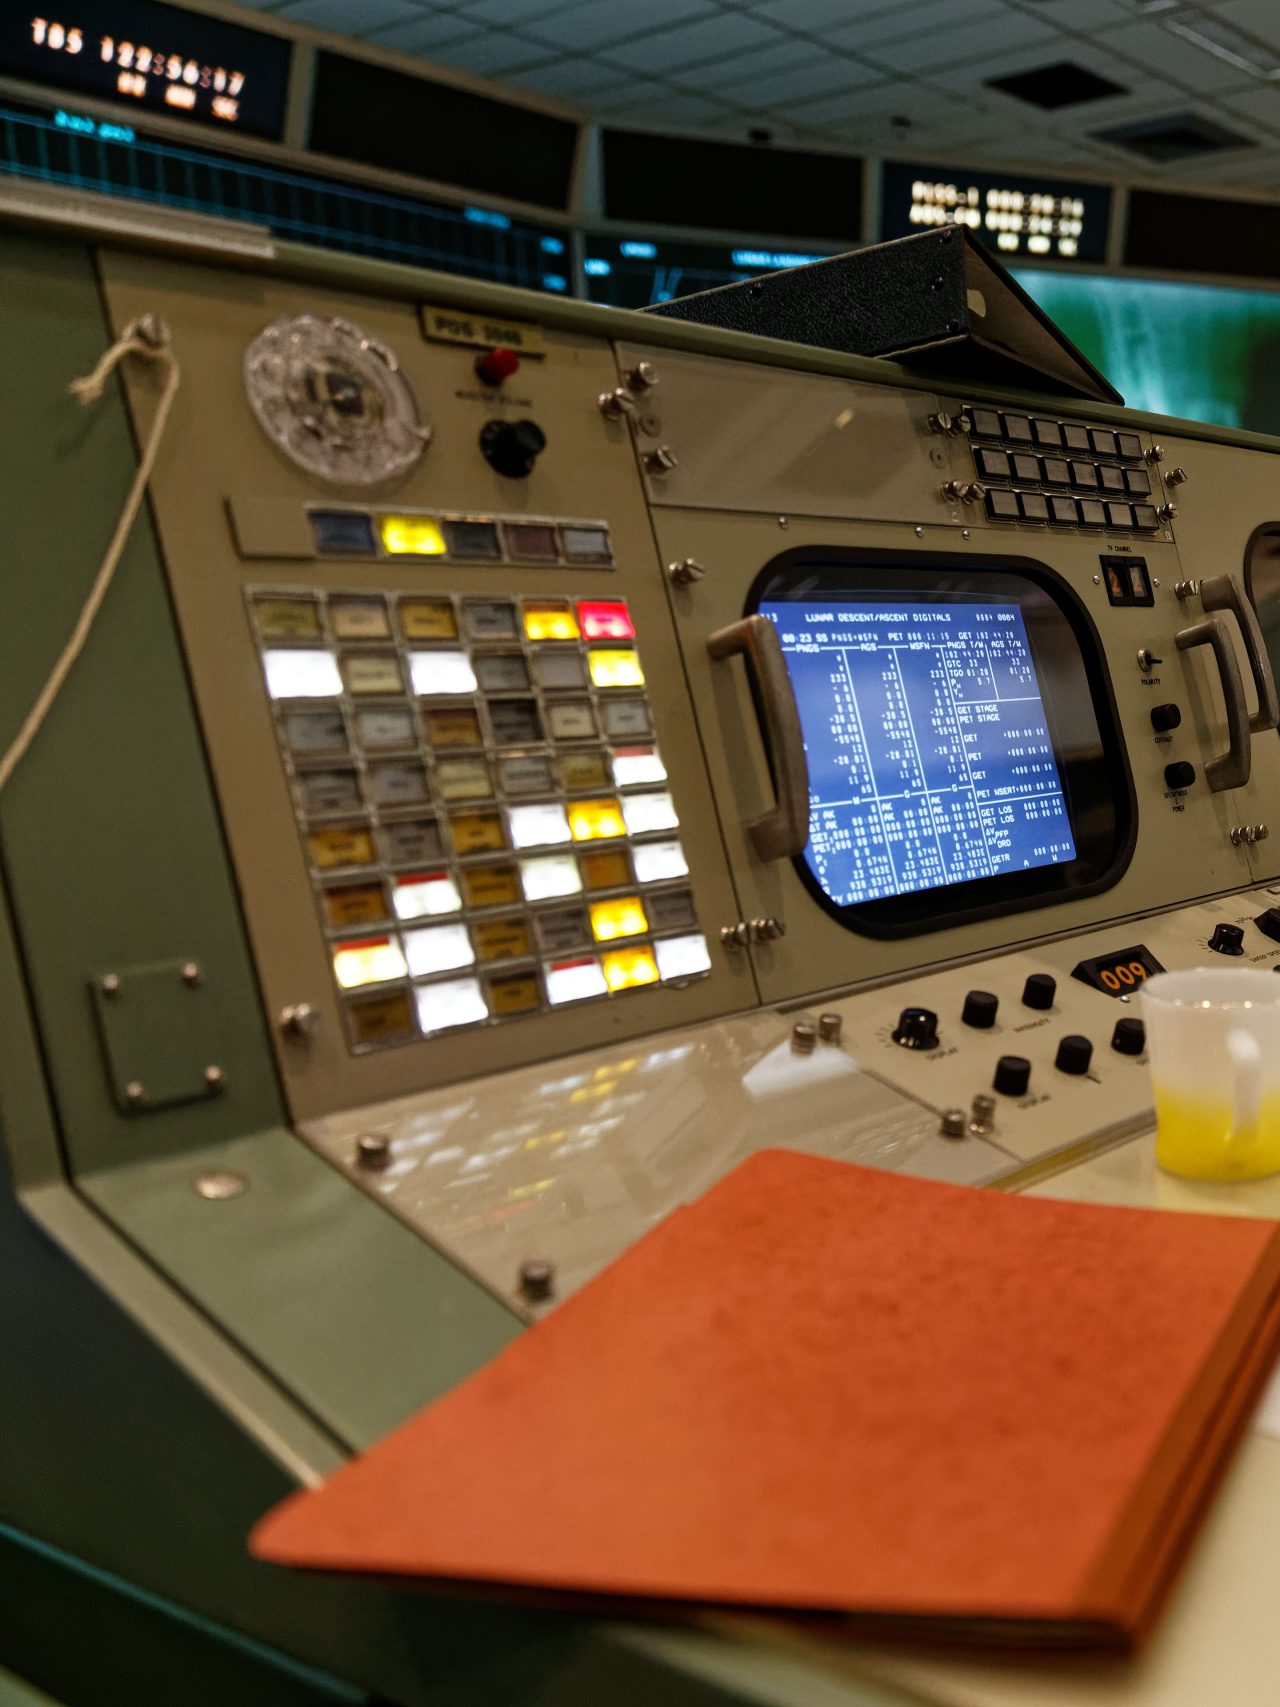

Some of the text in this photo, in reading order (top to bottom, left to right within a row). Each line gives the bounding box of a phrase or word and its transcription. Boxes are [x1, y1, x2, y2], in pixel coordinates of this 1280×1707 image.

[805, 613, 834, 623] LUNAR
[838, 613, 908, 622] DESCENT/ASCENT
[913, 613, 951, 622] DIGITALS
[888, 632, 904, 641] PET
[958, 632, 972, 640] GET
[860, 643, 878, 652] AGS
[946, 641, 967, 649] PNGS
[970, 640, 985, 649] T/M
[991, 640, 1005, 648] AGS
[1008, 640, 1022, 648] T/M
[946, 660, 962, 668] GTC
[950, 669, 964, 677] TGO
[958, 706, 971, 715] GET
[976, 704, 999, 713] STAGE
[960, 715, 973, 724] PET
[978, 714, 1000, 722] STAGE
[964, 734, 978, 743] GET
[968, 752, 982, 761] PET
[972, 771, 986, 780] GET
[976, 789, 990, 798] PET
[980, 808, 995, 818] GET
[998, 805, 1013, 815] LOS
[983, 817, 997, 827] PET
[1000, 814, 1015, 825] LOS
[992, 853, 1011, 864] GETR
[1100, 961, 1149, 991] 009
